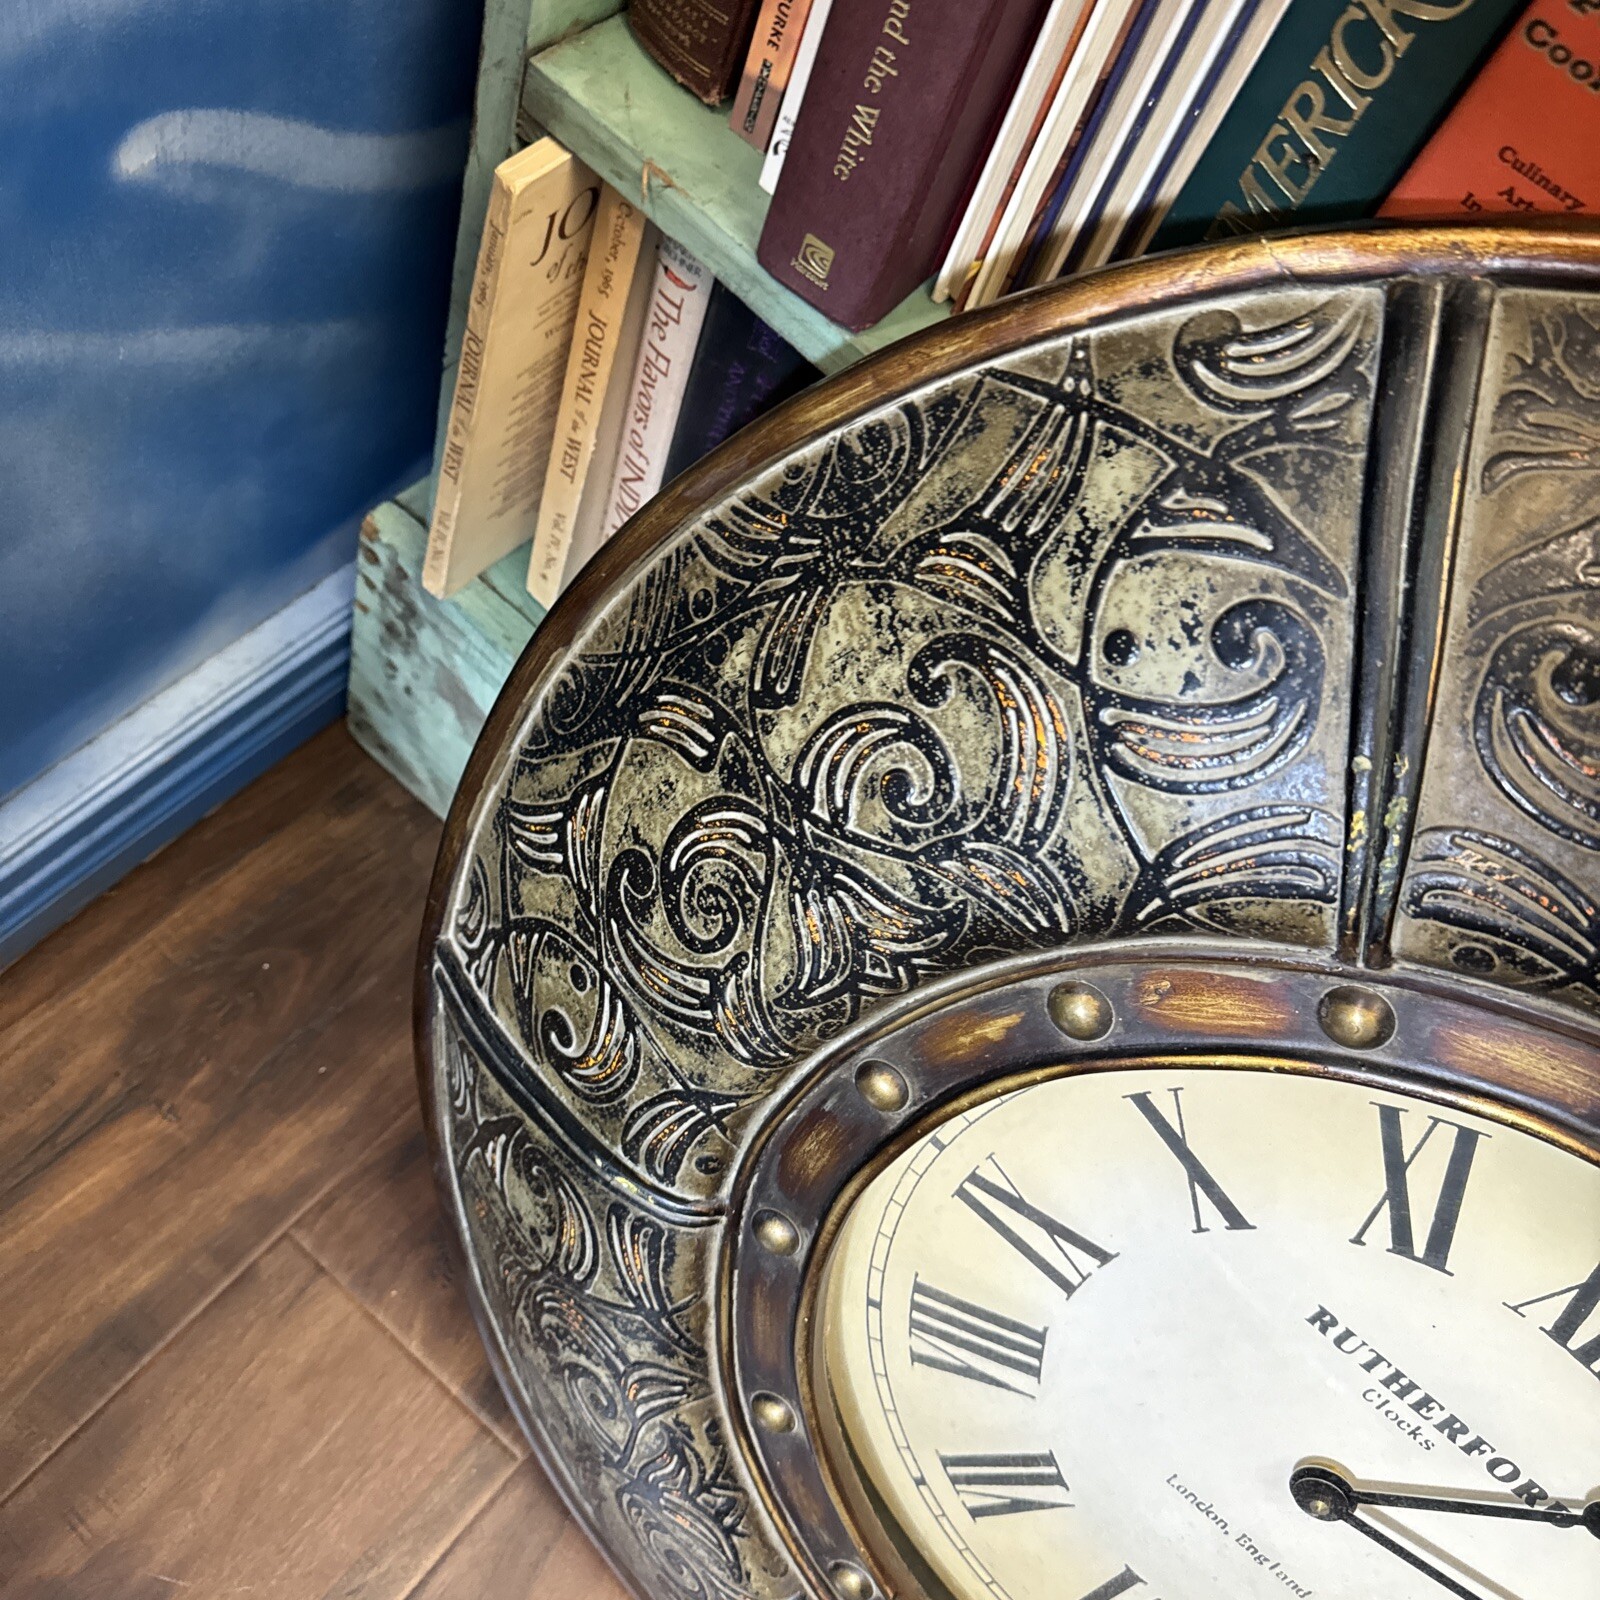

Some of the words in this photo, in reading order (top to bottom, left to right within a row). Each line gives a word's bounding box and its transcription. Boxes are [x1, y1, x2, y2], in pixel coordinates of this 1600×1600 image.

[767, 0, 792, 51] URKE
[864, 46, 898, 93] the
[833, 104, 881, 181] White
[1203, 0, 1474, 240] MERICK
[1498, 186, 1541, 212] Art
[1499, 146, 1587, 211] Culinary
[605, 202, 634, 263] October,
[597, 268, 614, 299] 1965
[650, 288, 685, 341] The
[456, 328, 483, 414] JOURNAL
[575, 309, 608, 405] JOURNAL
[633, 340, 671, 430] Flavors
[443, 440, 464, 485] WEST
[560, 437, 582, 484] WEST
[627, 428, 650, 466] of
[1122, 1087, 1257, 1233] X
[1348, 1100, 1492, 1277] XI
[951, 1152, 1121, 1300] IX
[1304, 1304, 1572, 1514] RUTHERFOR
[1361, 1387, 1436, 1451] Clocks
[1166, 1473, 1230, 1535] London,
[1235, 1533, 1312, 1600] England
